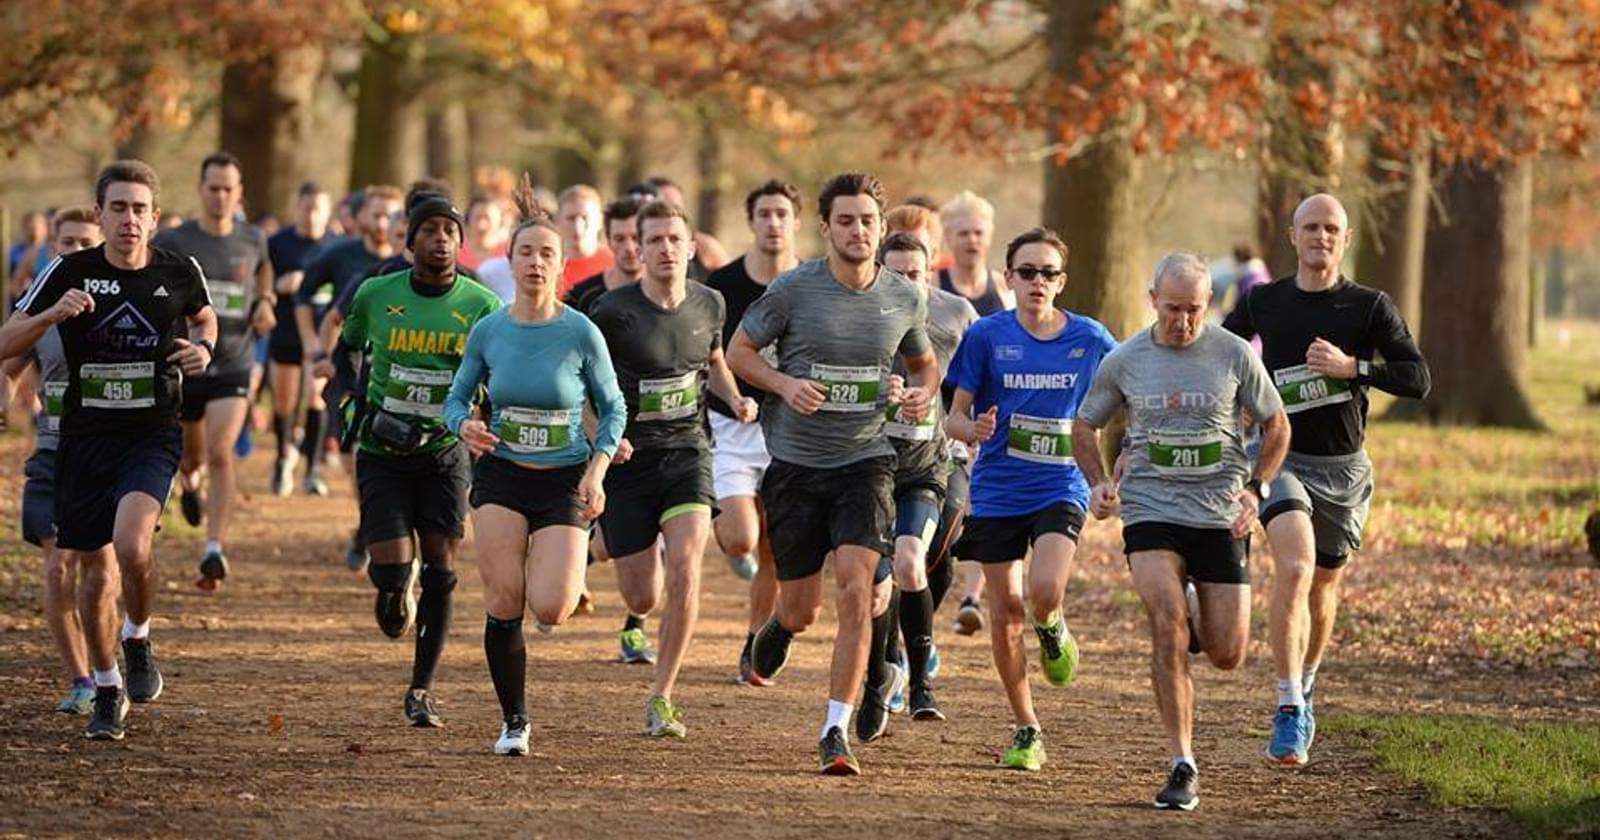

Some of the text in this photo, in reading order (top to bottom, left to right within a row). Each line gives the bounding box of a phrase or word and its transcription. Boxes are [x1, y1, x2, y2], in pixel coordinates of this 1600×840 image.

[83, 278, 121, 295] 1936
[387, 327, 466, 356] JAMAICA
[103, 381, 133, 400] 458
[1003, 373, 1078, 389] HARINGEY
[1300, 378, 1328, 401] 480
[406, 385, 431, 403] 215
[830, 384, 859, 403] 528
[518, 426, 548, 447] 509
[1030, 434, 1058, 455] 501
[1171, 448, 1200, 467] 201
